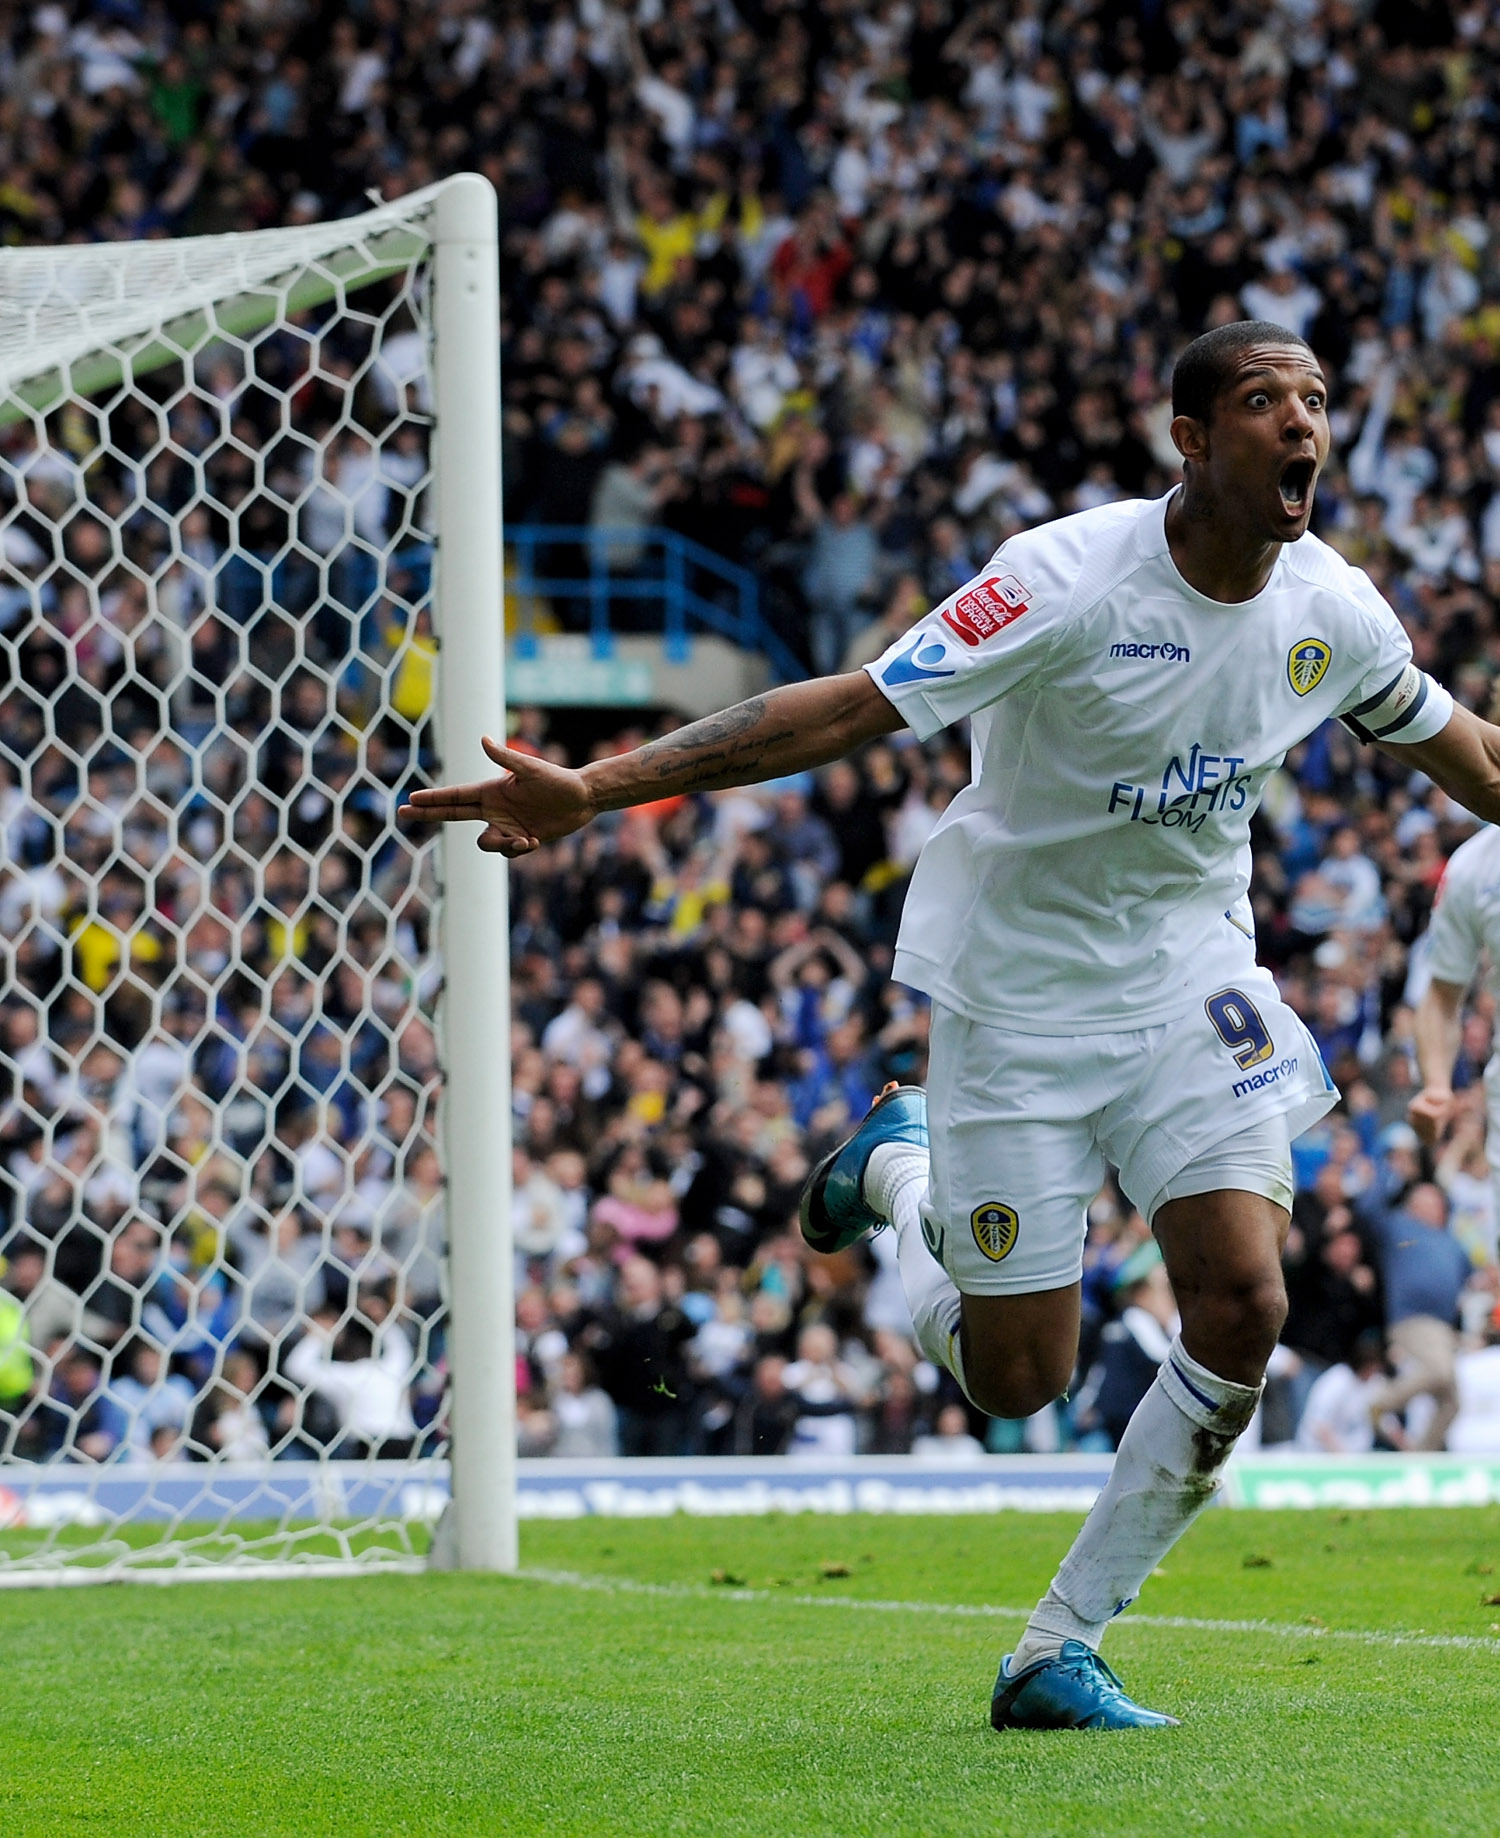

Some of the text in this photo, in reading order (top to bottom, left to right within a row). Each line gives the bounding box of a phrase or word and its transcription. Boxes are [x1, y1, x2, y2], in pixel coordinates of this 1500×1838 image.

[957, 601, 992, 635] LEAGUE
[965, 596, 996, 629] FOOTBALL
[1109, 642, 1190, 662] macron
[1162, 742, 1245, 793] NET
[1204, 988, 1275, 1071] 9
[1232, 1058, 1298, 1098] macron
